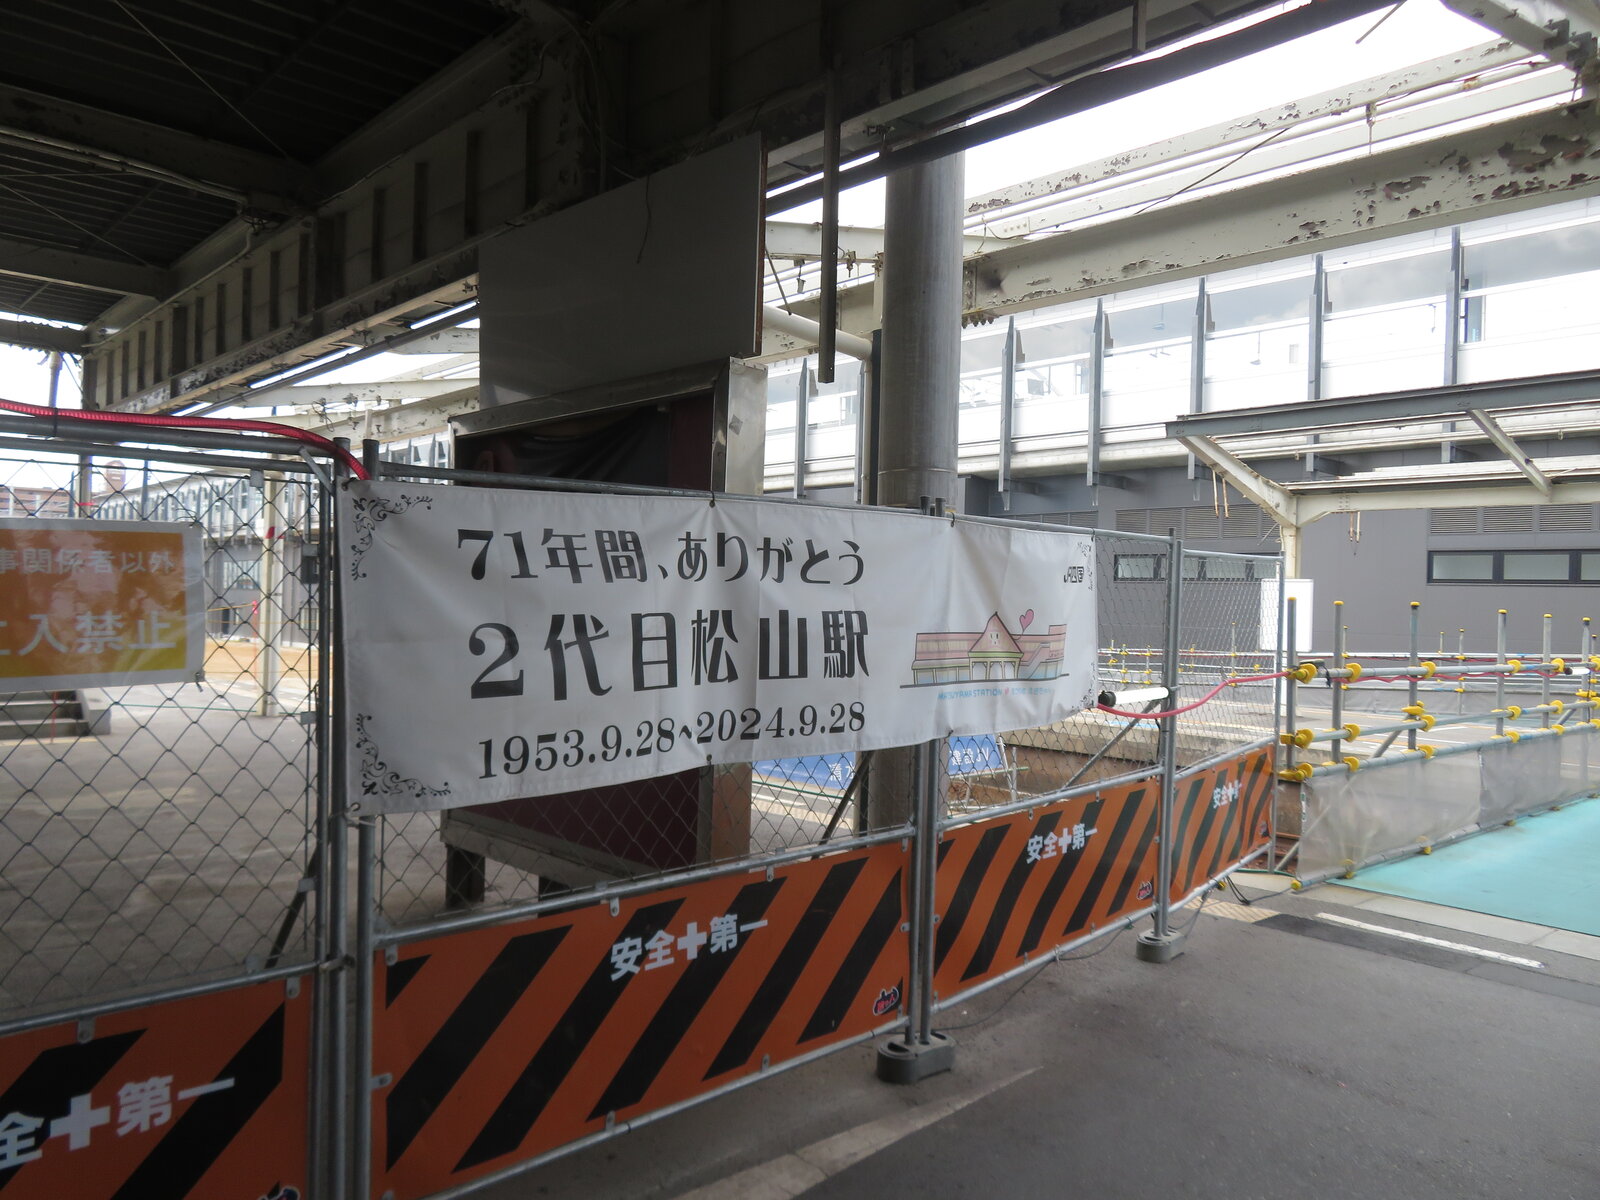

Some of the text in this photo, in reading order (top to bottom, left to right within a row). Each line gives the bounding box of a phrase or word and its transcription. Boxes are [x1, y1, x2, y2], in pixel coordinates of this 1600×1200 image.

[0, 609, 176, 657] 入禁止
[468, 609, 869, 701] 2代目松山駅
